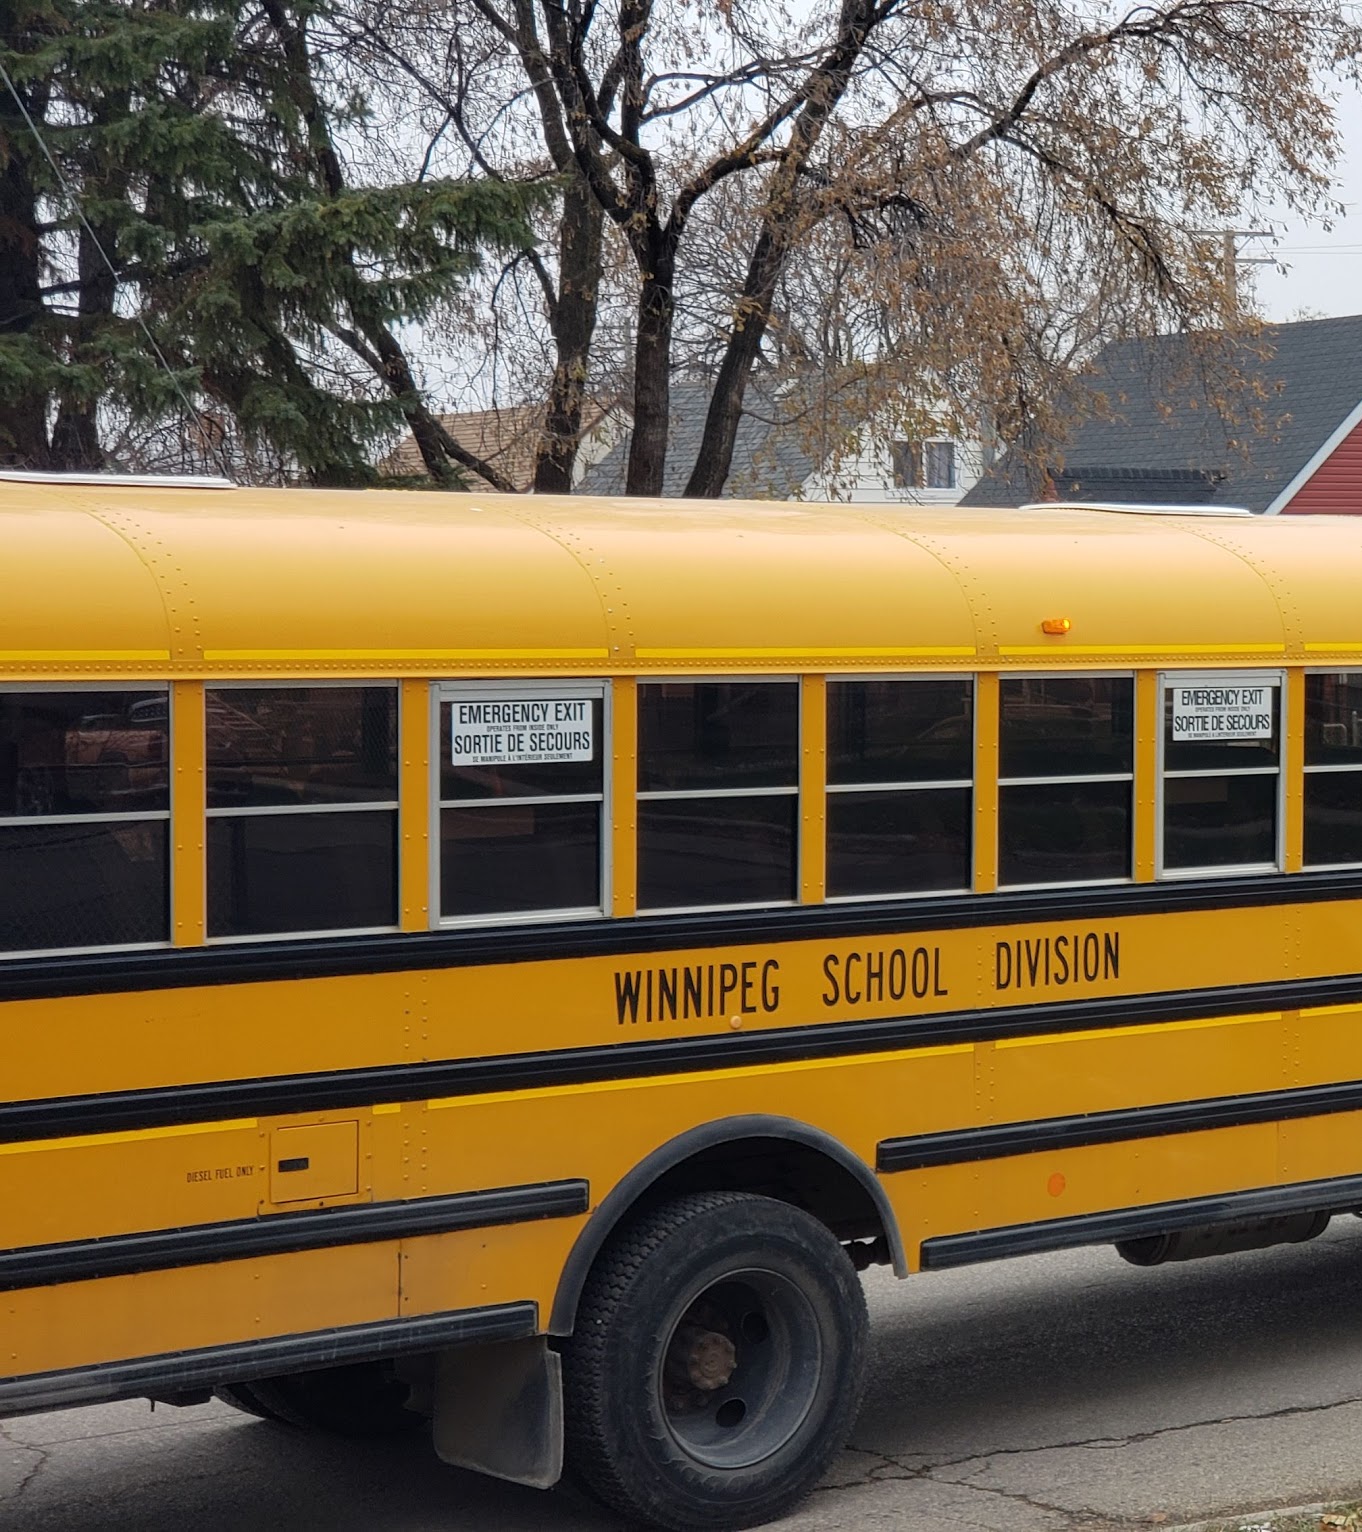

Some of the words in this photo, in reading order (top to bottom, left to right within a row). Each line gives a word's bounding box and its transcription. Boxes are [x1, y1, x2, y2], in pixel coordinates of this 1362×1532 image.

[1182, 689, 1240, 706] EMERGENCY
[1242, 689, 1264, 705] EXIT
[459, 703, 549, 724] EMERGENCY
[555, 702, 586, 722] EXIT
[513, 724, 527, 732] FROM
[1174, 715, 1209, 732] SORTIE
[1212, 715, 1224, 731] DE
[1226, 714, 1270, 730] SECOURS
[454, 733, 502, 754] SORTIE
[508, 733, 524, 753] DE
[529, 731, 590, 751] SECOURS
[614, 958, 780, 1025] WINNIPEG
[822, 946, 948, 1007] SCHOOL
[996, 931, 1120, 991] DIVISION
[186, 1171, 212, 1183] DIESEL
[215, 1168, 233, 1179] FUEL
[236, 1165, 254, 1177] ONLY
